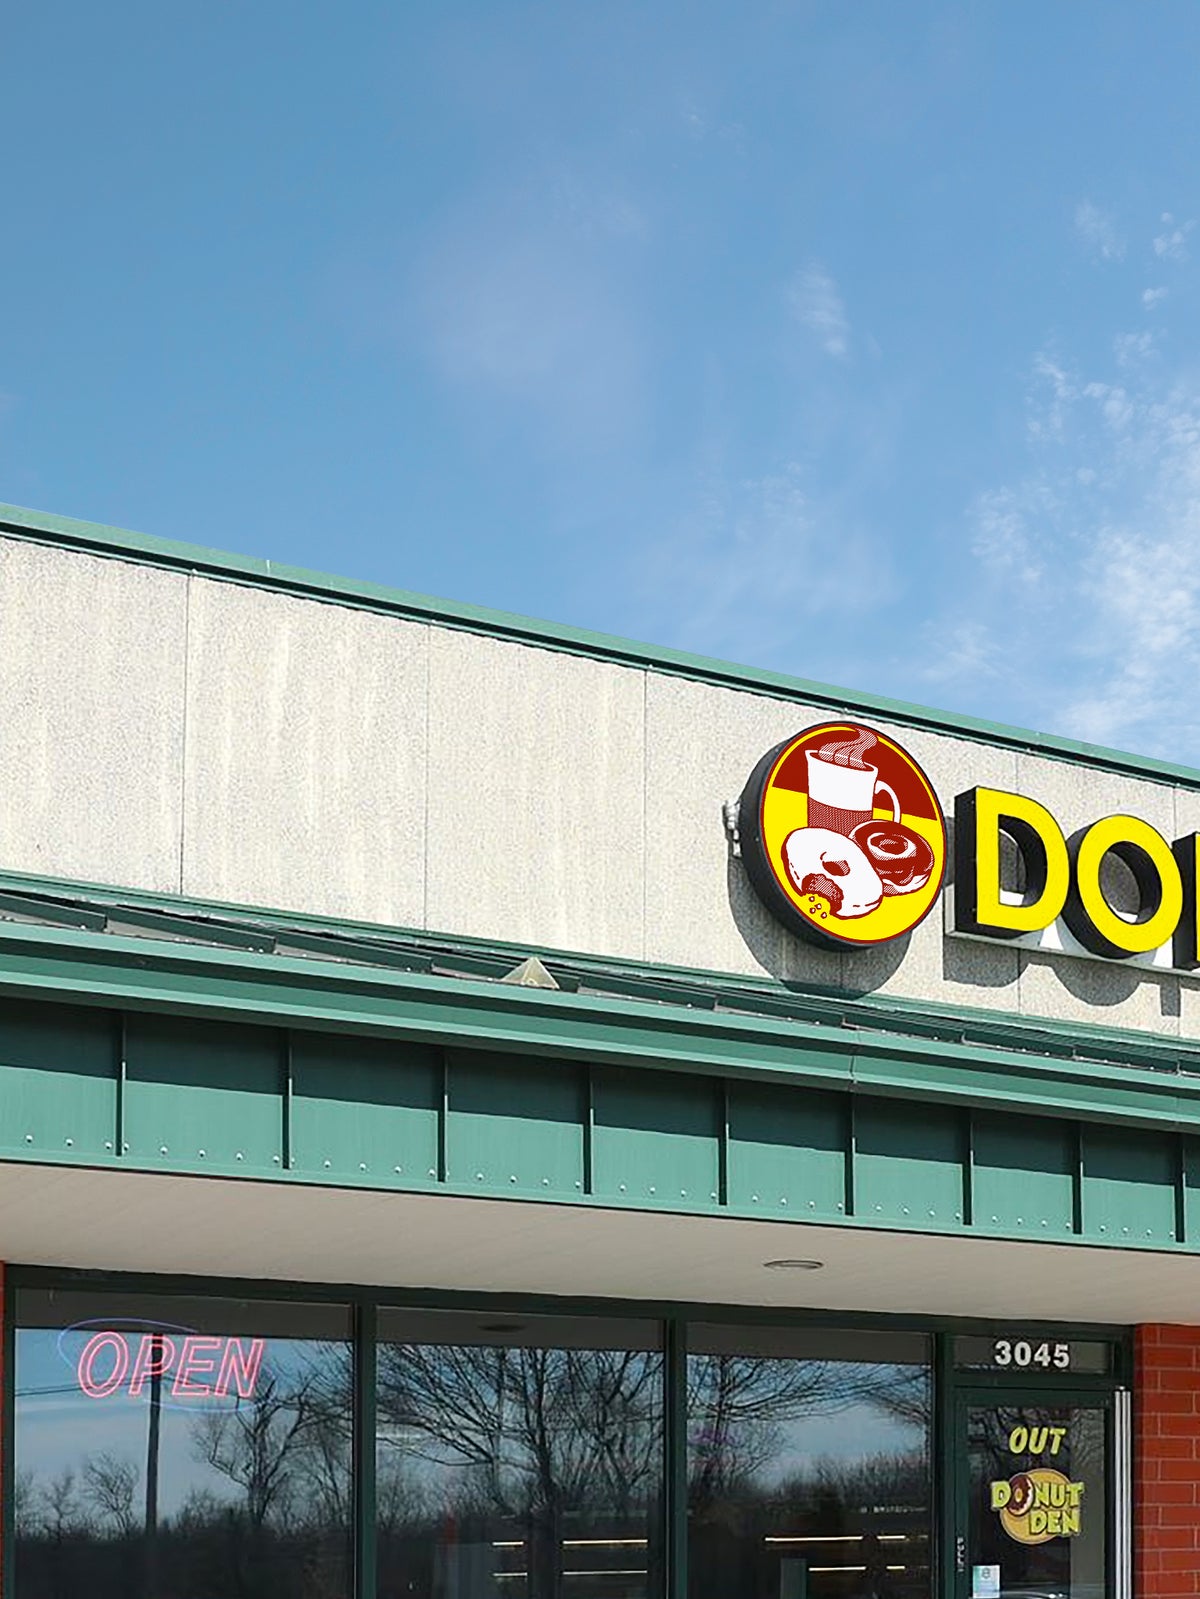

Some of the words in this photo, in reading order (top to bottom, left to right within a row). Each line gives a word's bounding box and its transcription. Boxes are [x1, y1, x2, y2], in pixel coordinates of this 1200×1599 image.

[77, 1331, 265, 1398] OPEN
[994, 1340, 1070, 1368] 3045
[1009, 1426, 1066, 1455] OUT
[991, 1474, 1085, 1516] DONUT
[1029, 1509, 1080, 1536] DEN
